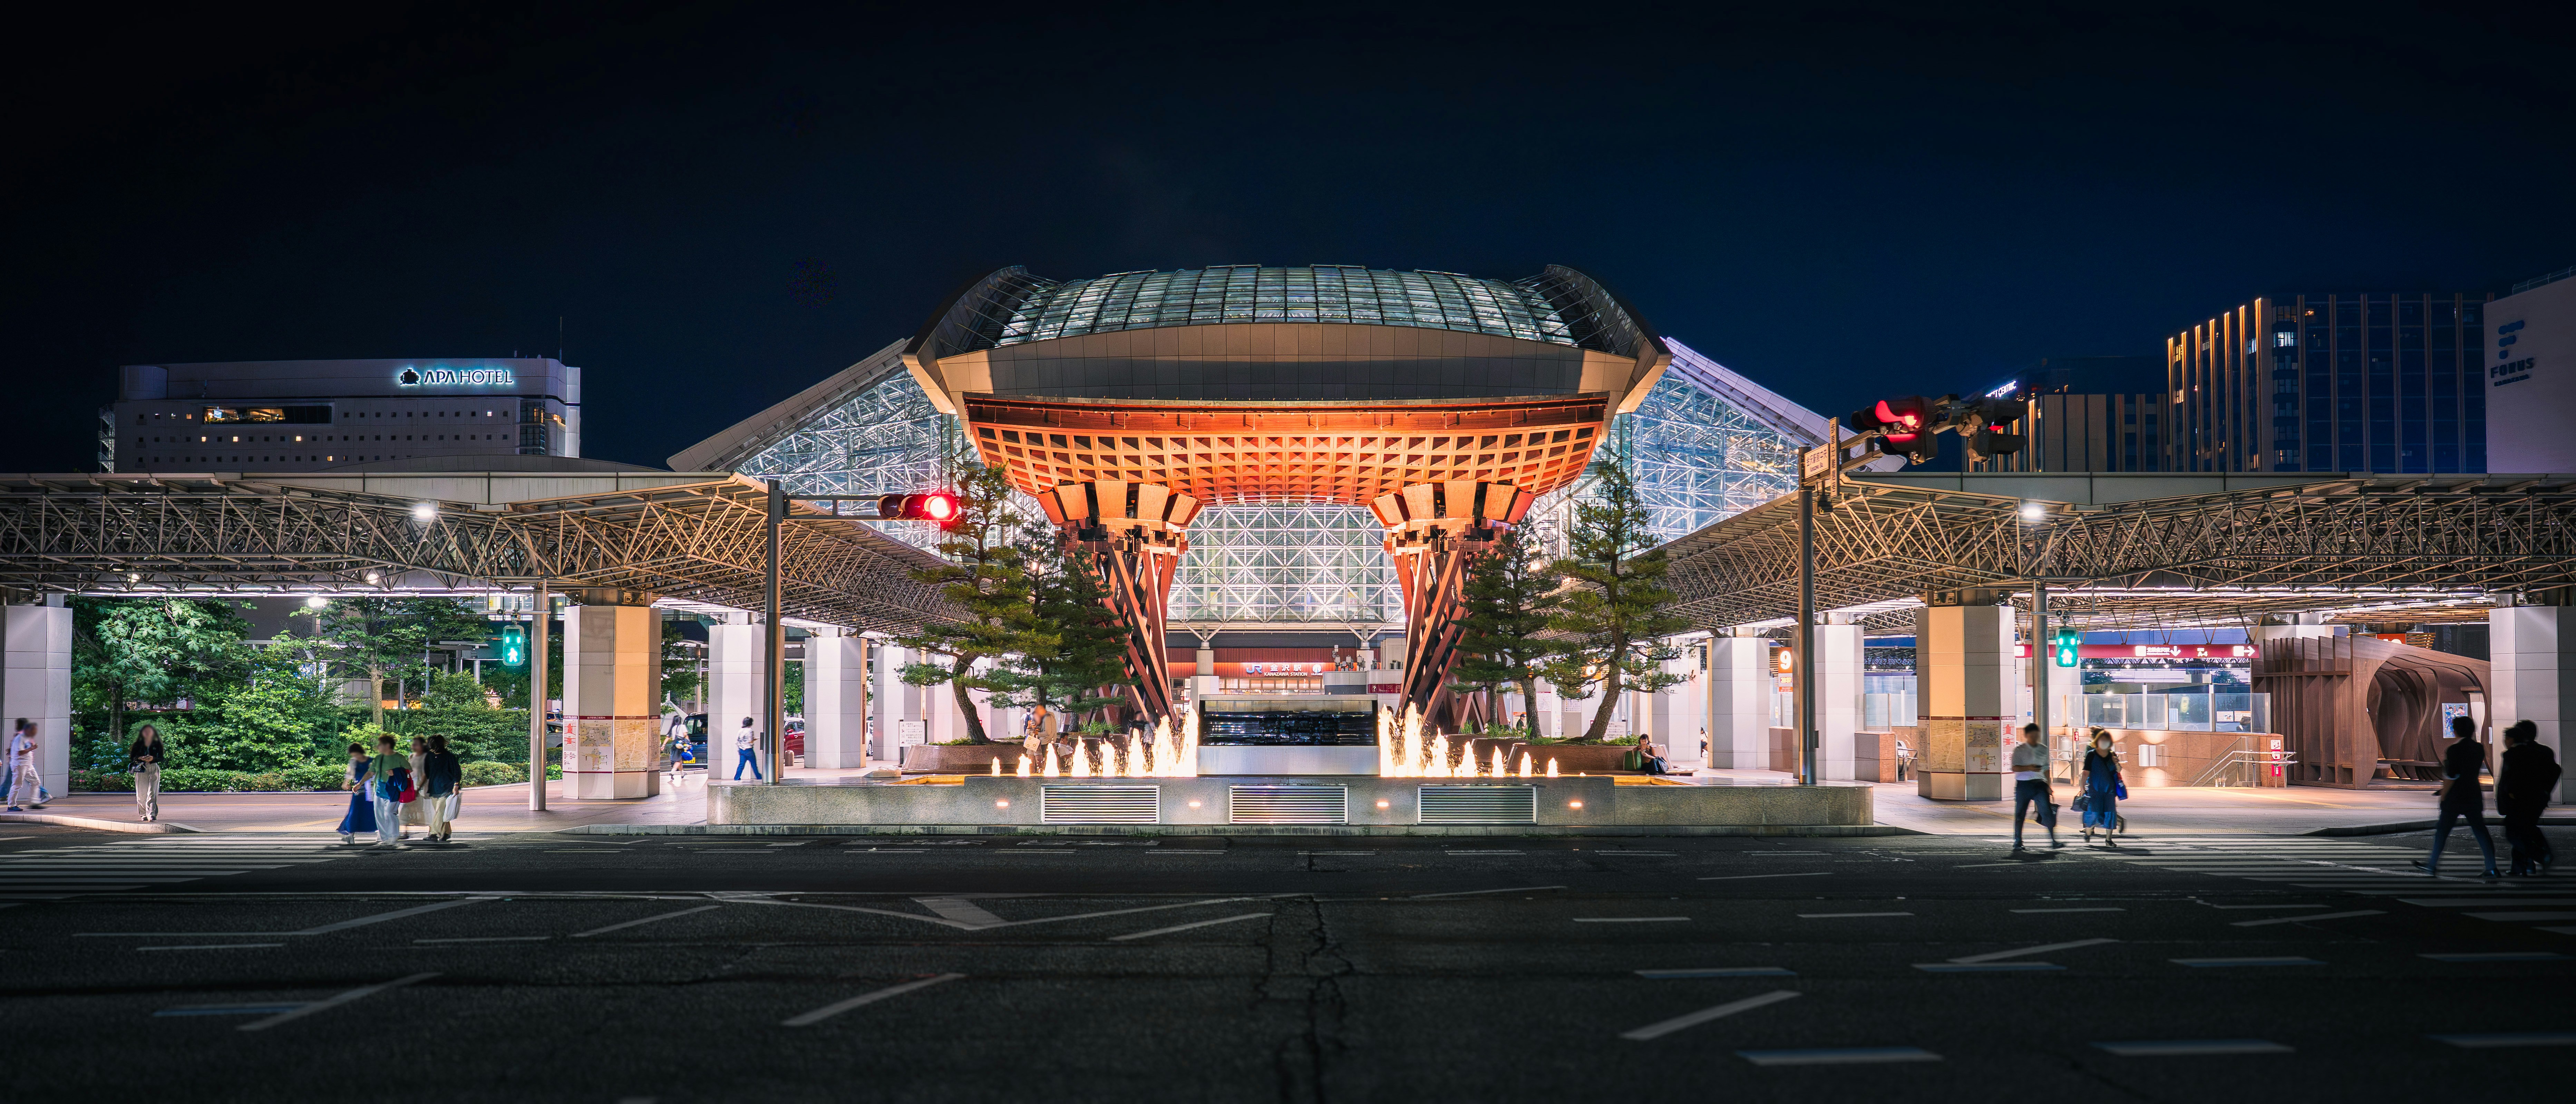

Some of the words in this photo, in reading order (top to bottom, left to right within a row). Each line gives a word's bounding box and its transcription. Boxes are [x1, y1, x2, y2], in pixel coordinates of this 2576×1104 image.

[2490, 357, 2534, 379] FORUS
[424, 371, 455, 383] APA
[459, 370, 513, 383] HOTEL
[1780, 650, 1792, 670] 9
[1246, 664, 1262, 673] JR
